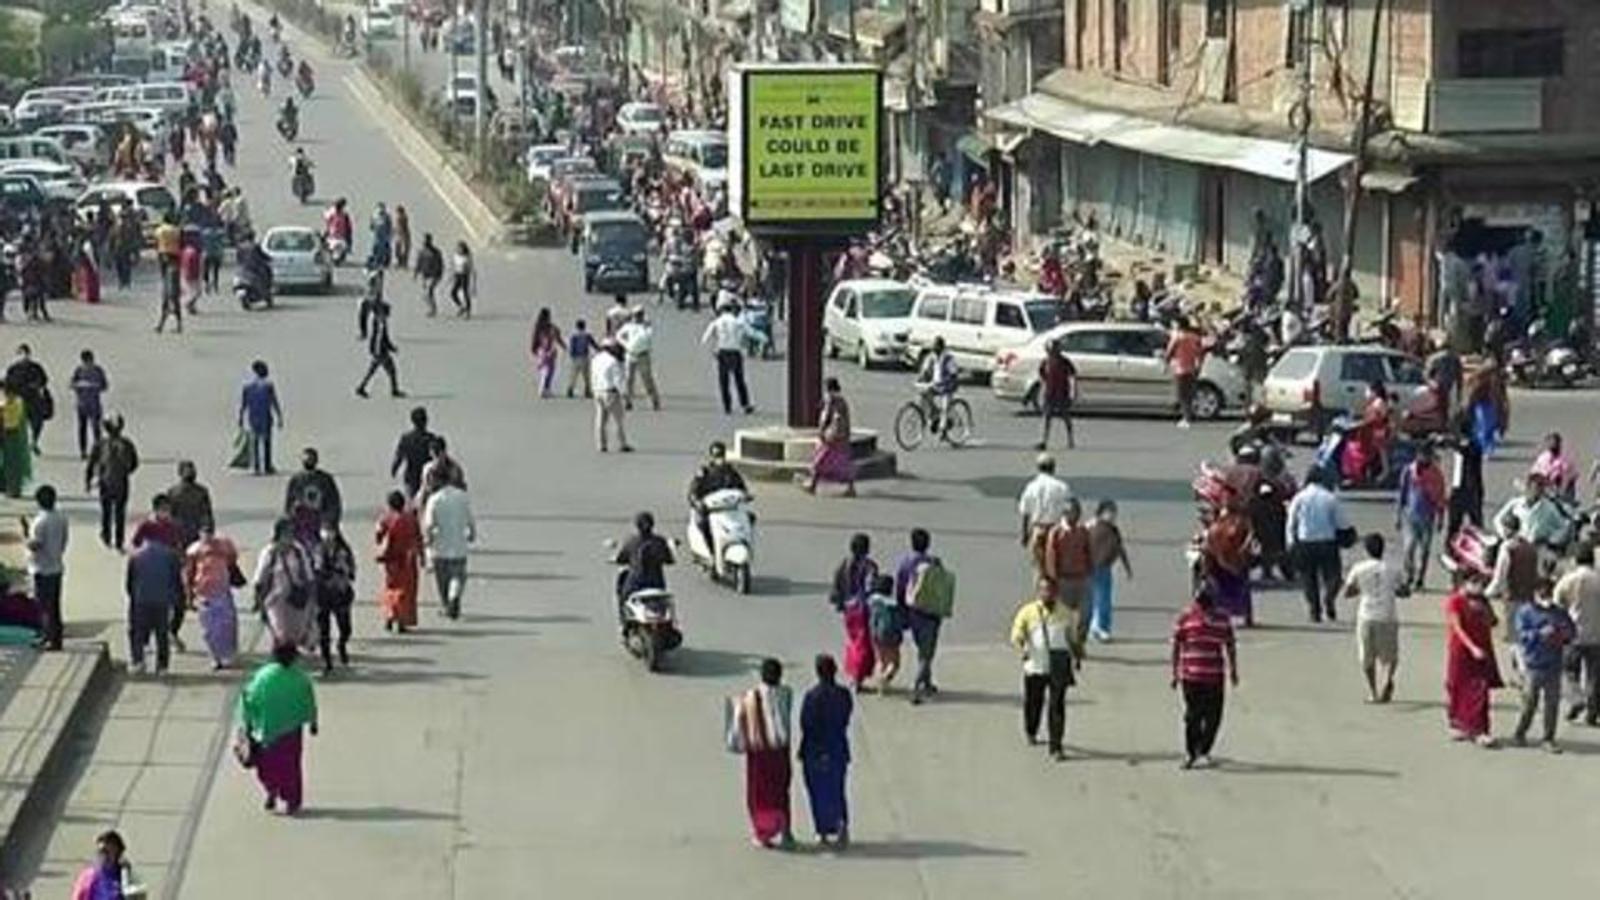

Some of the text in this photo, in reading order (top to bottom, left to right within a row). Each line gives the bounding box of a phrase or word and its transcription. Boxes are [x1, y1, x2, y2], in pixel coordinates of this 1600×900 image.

[759, 115, 867, 129] FAST DRIVE
[766, 139, 861, 154] COULD BE
[759, 163, 867, 178] LAST DRIVE
